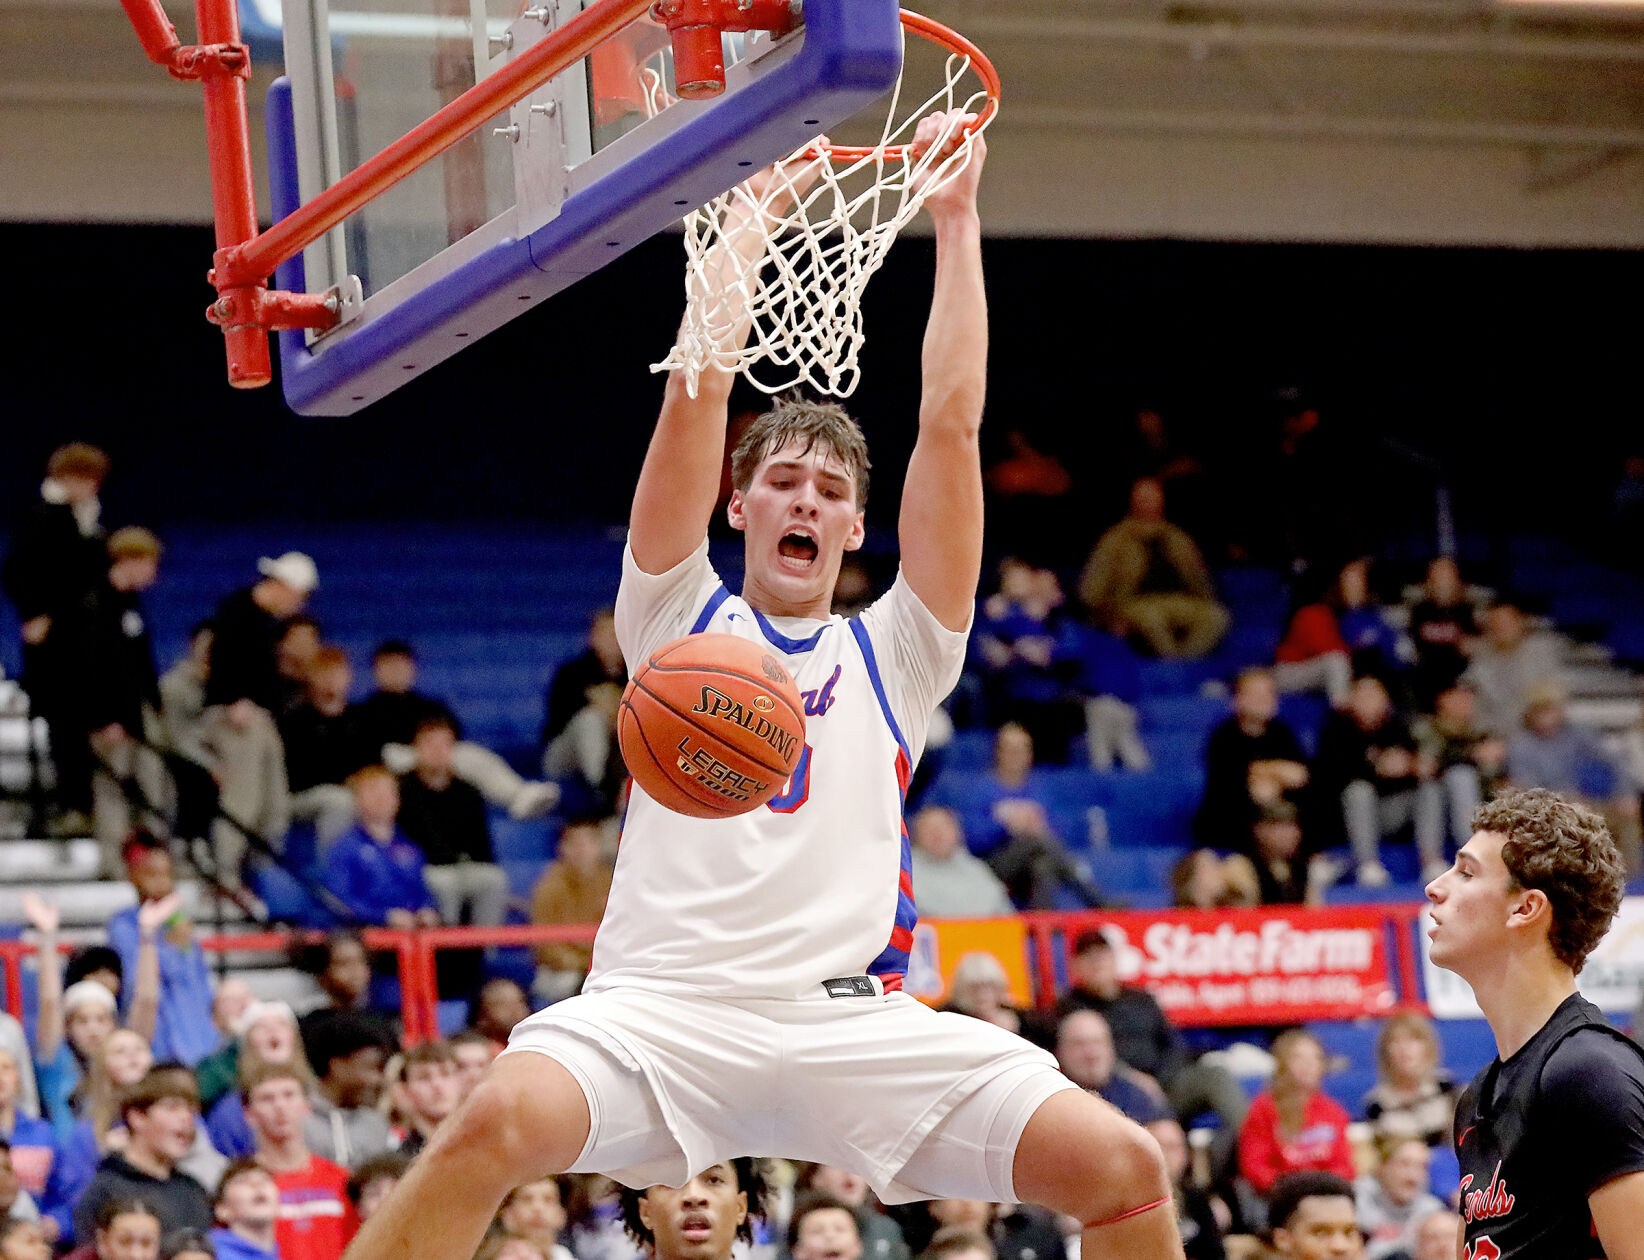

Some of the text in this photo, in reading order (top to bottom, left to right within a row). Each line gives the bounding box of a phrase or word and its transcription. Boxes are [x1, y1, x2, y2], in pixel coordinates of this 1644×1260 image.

[692, 685, 799, 765] SPALDING
[677, 735, 772, 796] LEGACY
[856, 981, 869, 990] XL
